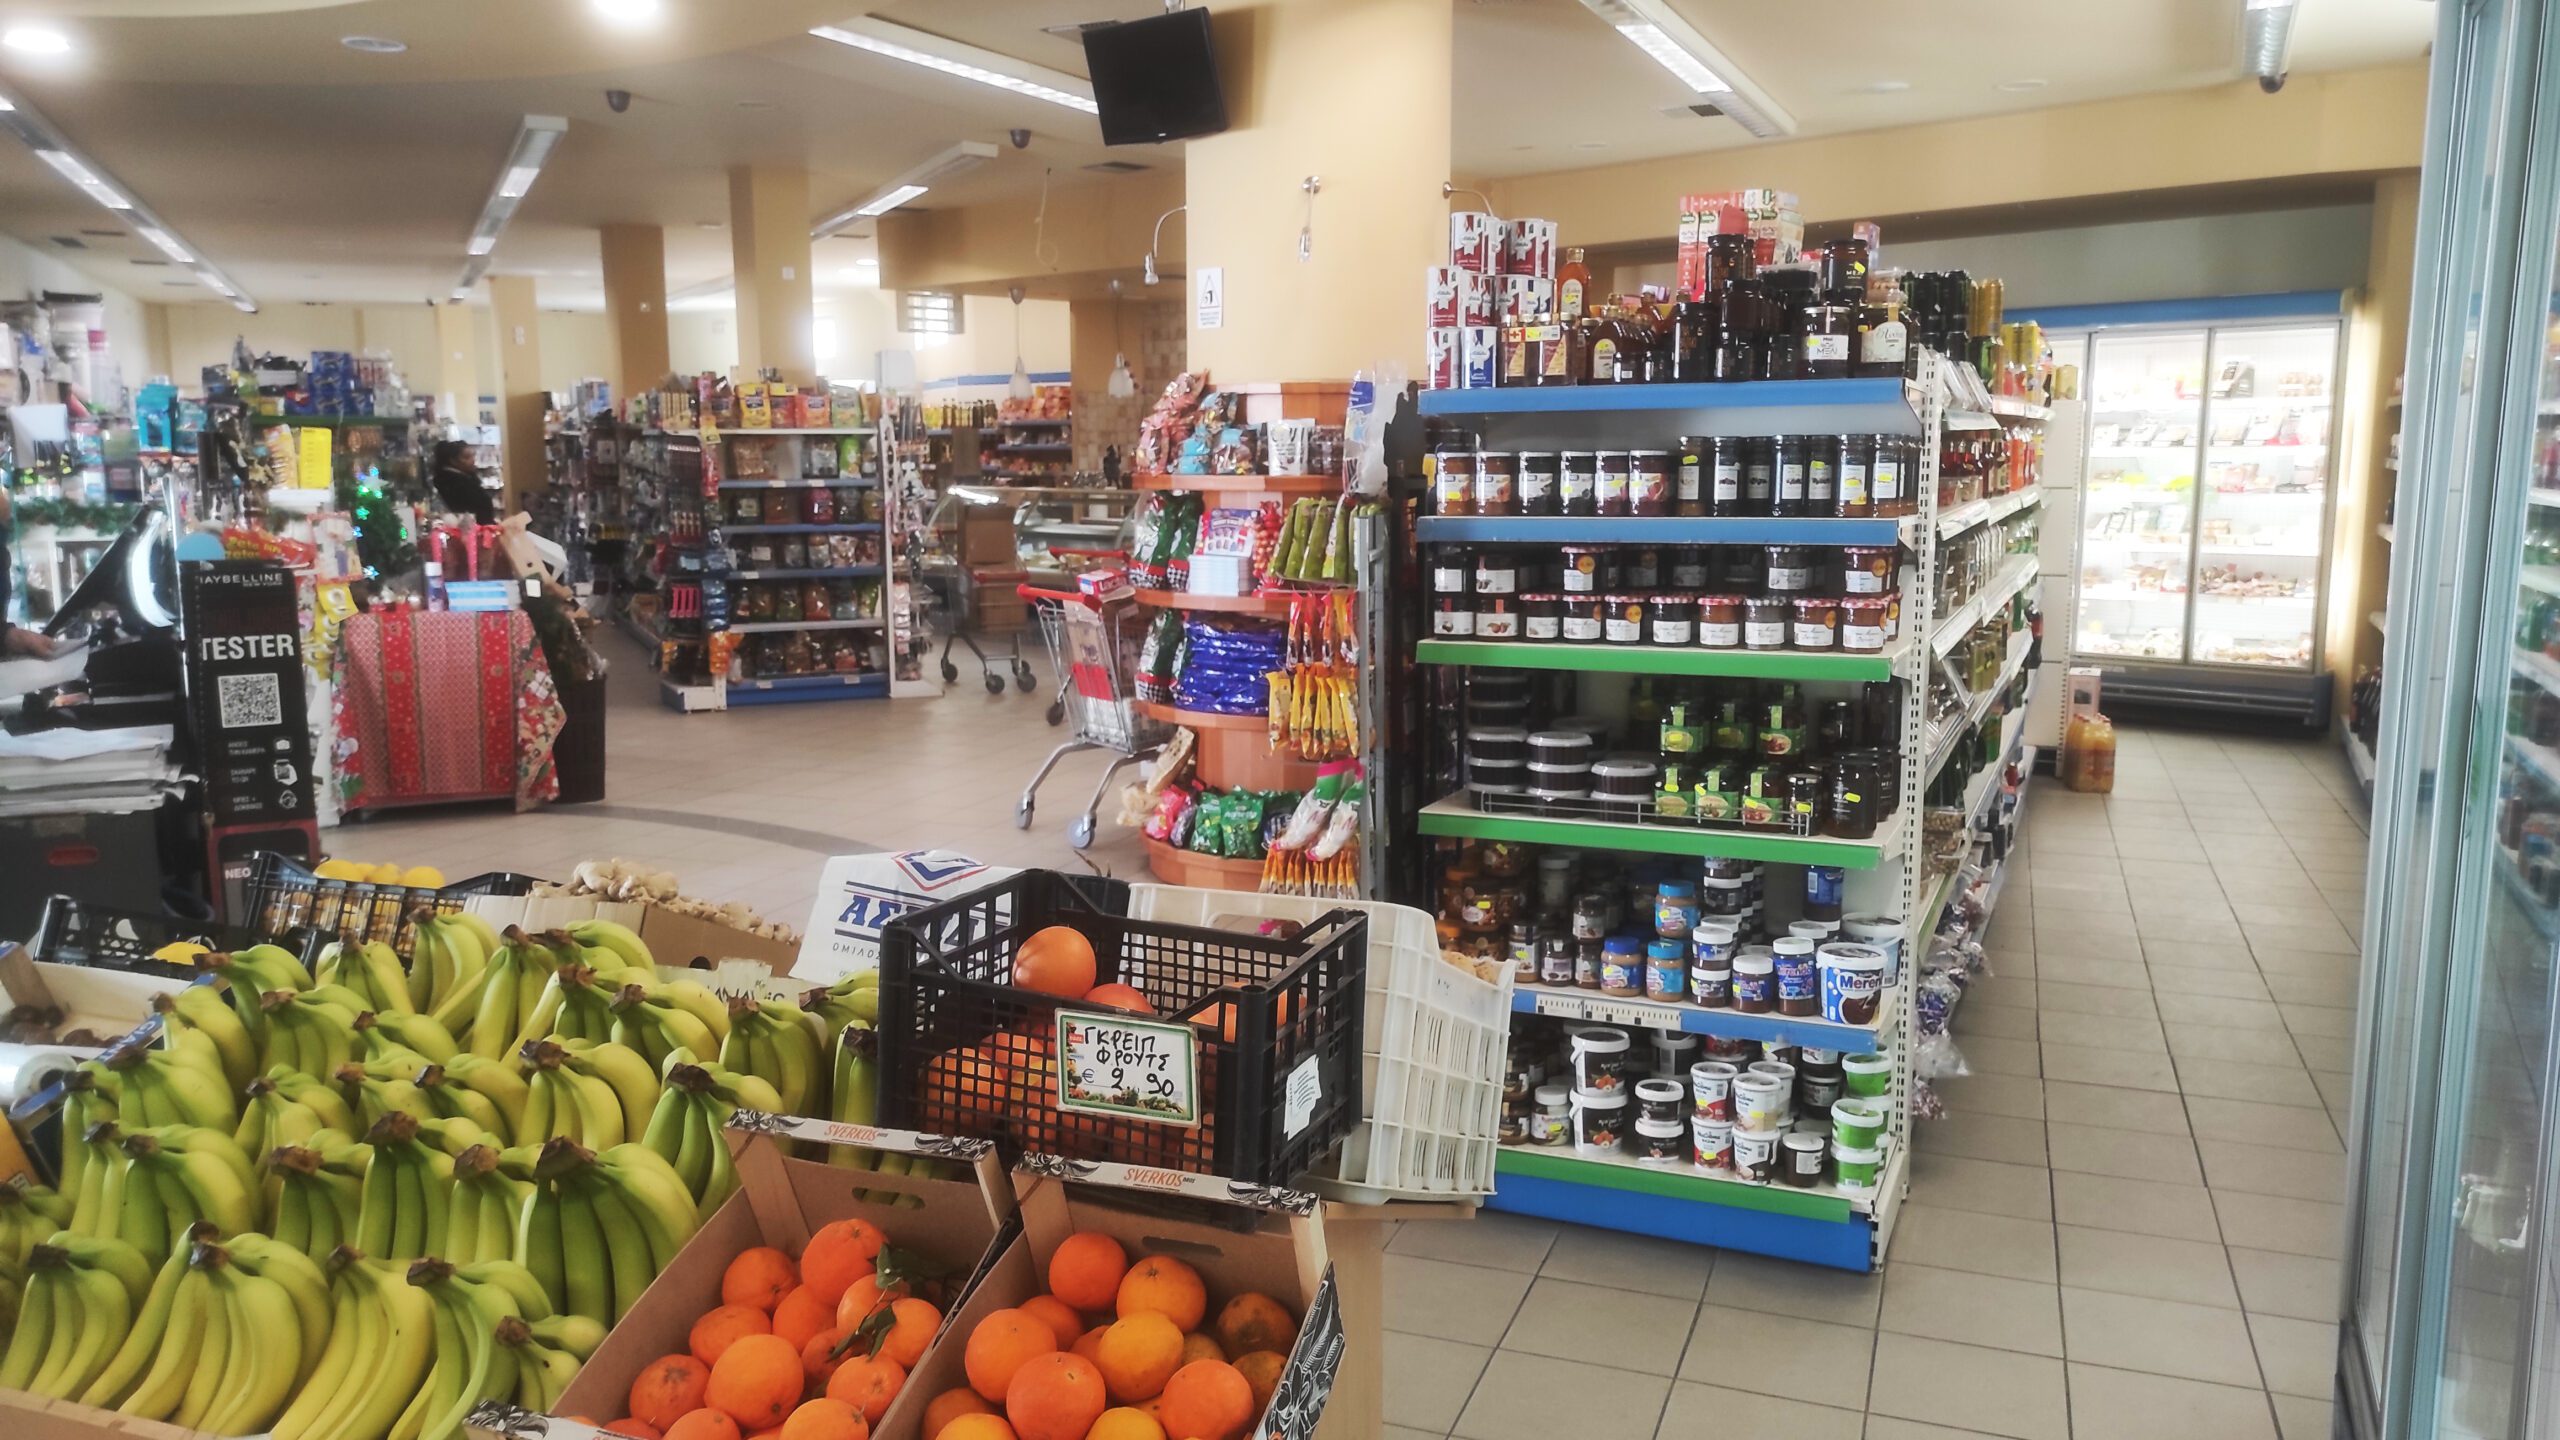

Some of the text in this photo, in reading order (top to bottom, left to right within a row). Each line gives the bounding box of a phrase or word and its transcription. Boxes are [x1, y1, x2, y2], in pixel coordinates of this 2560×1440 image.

[202, 634, 295, 661] TESTER
[1084, 1026, 1156, 1053] ΓΚΡΕΙΠ
[1096, 1046, 1170, 1071] ΦΡΟΥΤΣ
[1146, 1073, 1175, 1097] 90
[824, 1124, 879, 1142] SVERKOS
[1124, 1168, 1184, 1188] SVERKOS
